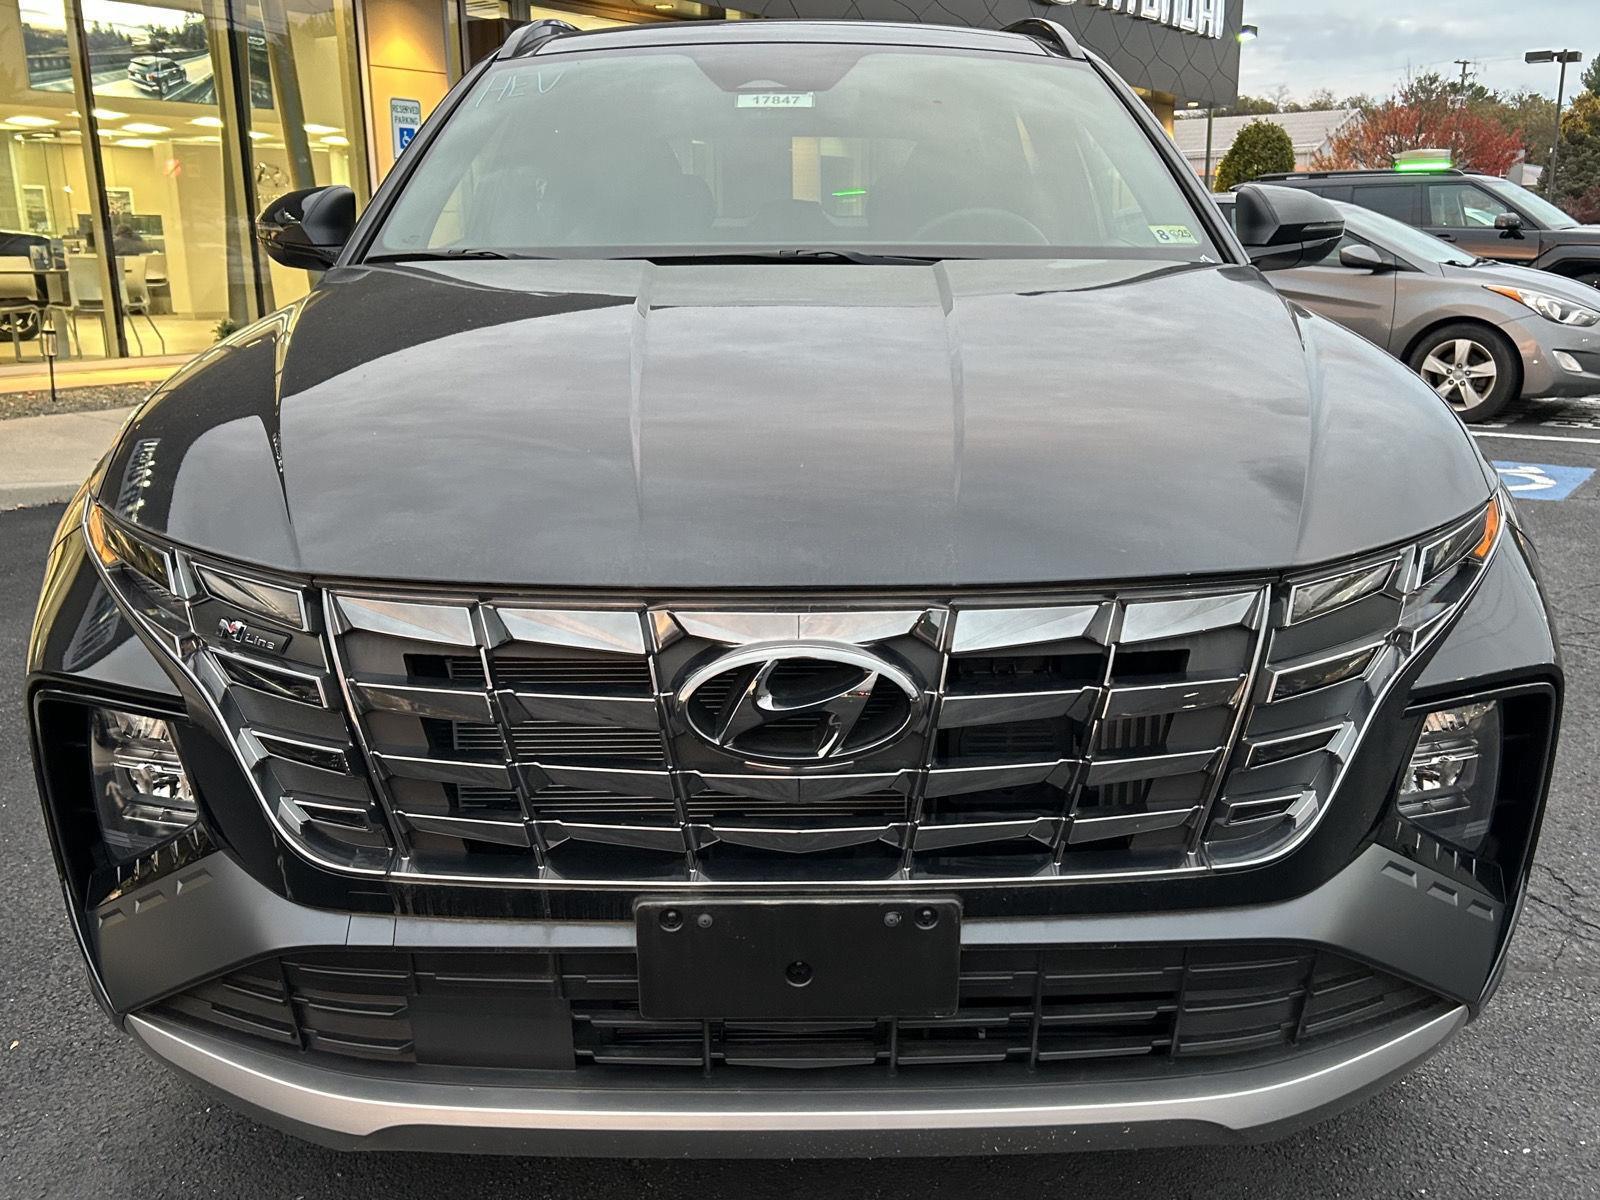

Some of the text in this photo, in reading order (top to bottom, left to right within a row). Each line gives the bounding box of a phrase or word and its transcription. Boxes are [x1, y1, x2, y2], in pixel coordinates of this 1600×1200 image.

[752, 95, 801, 105] 17847
[391, 104, 419, 115] RESERVED
[394, 115, 418, 126] PARKING
[1156, 229, 1170, 240] 8
[244, 633, 275, 650] Line
